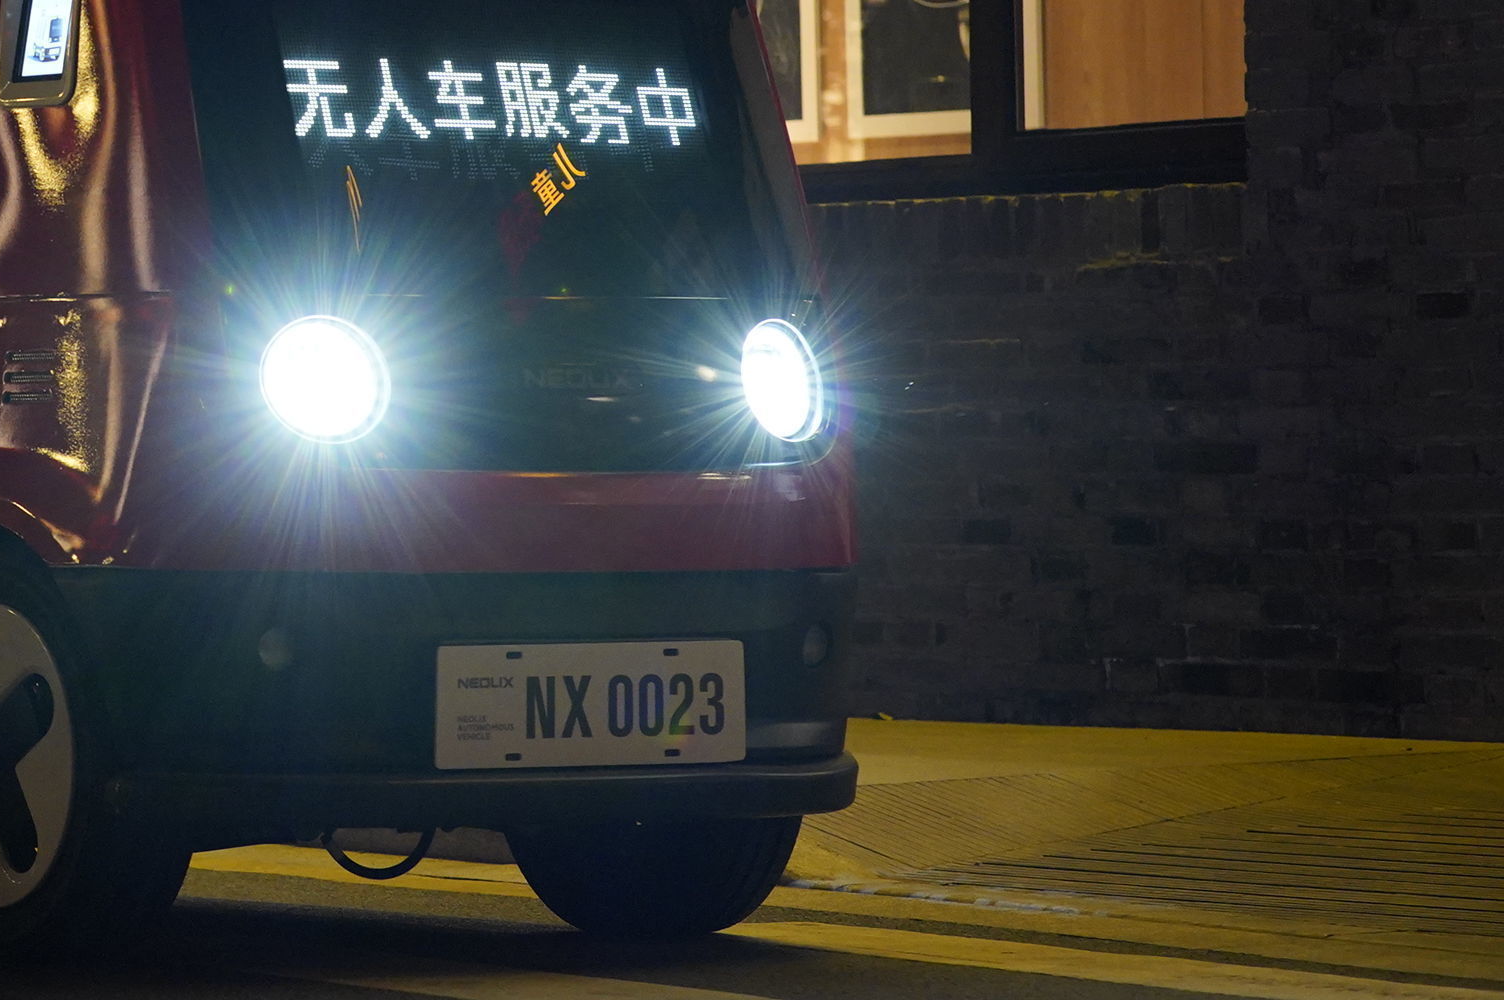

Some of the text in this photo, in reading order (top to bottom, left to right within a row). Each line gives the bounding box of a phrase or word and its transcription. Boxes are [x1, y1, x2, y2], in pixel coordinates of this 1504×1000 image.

[283, 57, 696, 147] 无人车服务中
[456, 676, 514, 689] NEOLIX
[525, 672, 726, 740] NX 0023
